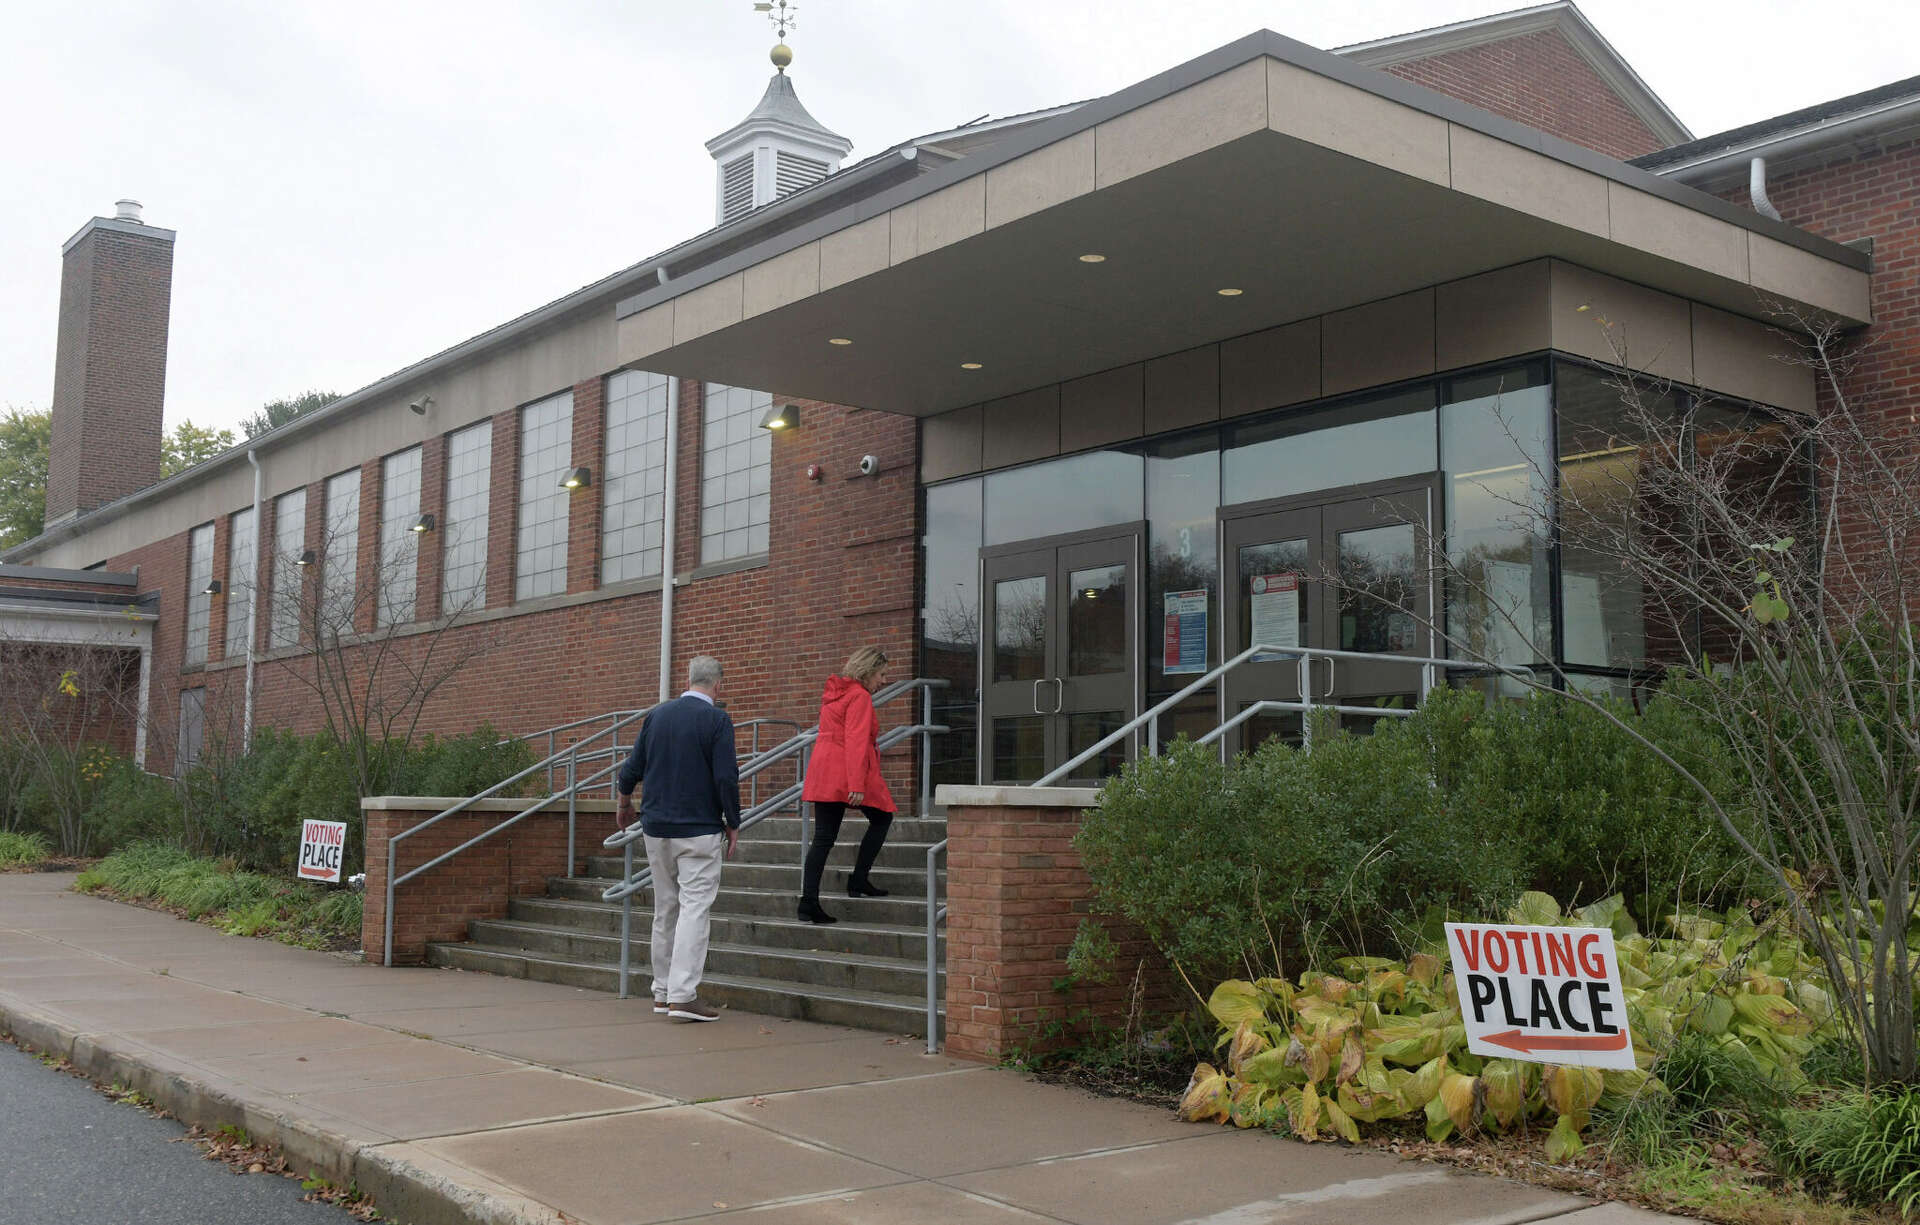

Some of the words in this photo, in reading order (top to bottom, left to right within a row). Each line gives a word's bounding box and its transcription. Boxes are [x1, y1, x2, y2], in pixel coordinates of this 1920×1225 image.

[1178, 527, 1191, 558] 3
[306, 824, 343, 845] VOTING
[303, 843, 339, 868] PLACE
[1454, 928, 1607, 979] VOTING
[1467, 974, 1618, 1034] PLACE
